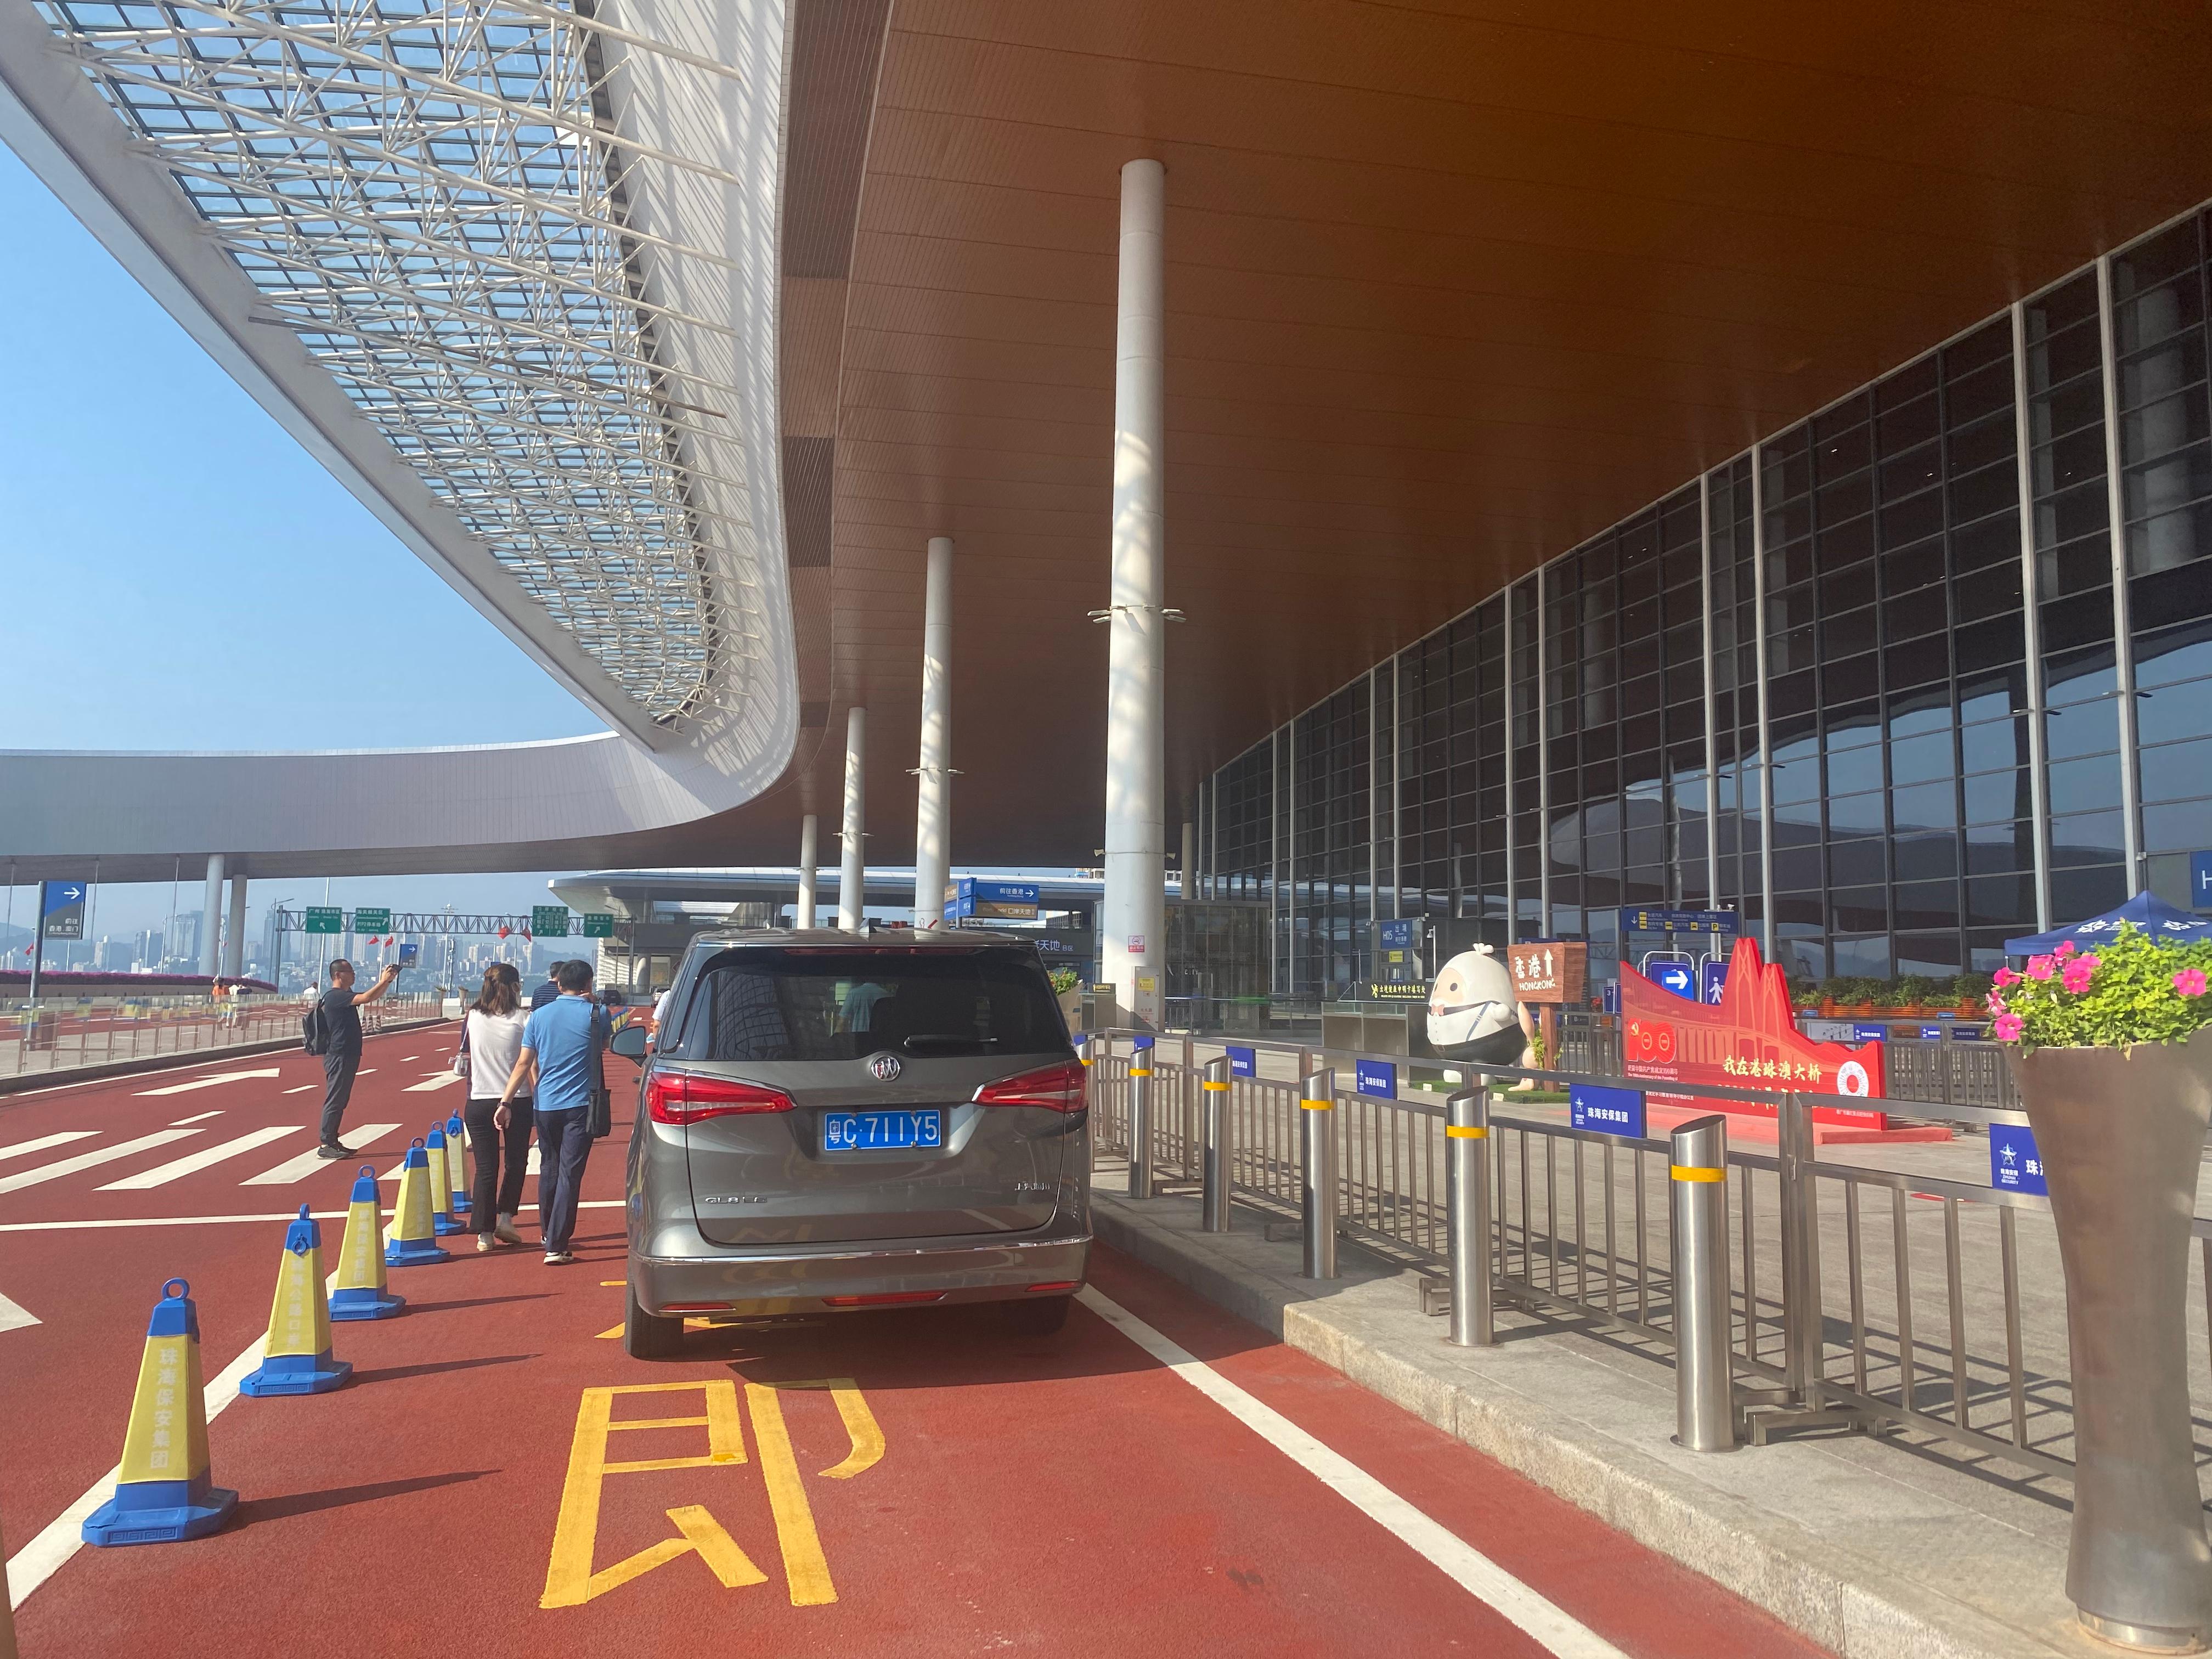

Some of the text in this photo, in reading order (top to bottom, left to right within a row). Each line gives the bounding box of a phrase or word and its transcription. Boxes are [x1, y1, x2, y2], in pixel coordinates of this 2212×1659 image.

[1383, 930, 1393, 941] H05
[1515, 953, 1541, 979] 香港
[1723, 1055, 1822, 1085] 我在港珠澳大桥
[1587, 1107, 1628, 1124] 珠海安保集团
[150, 1347, 179, 1469] 珠海保安集团
